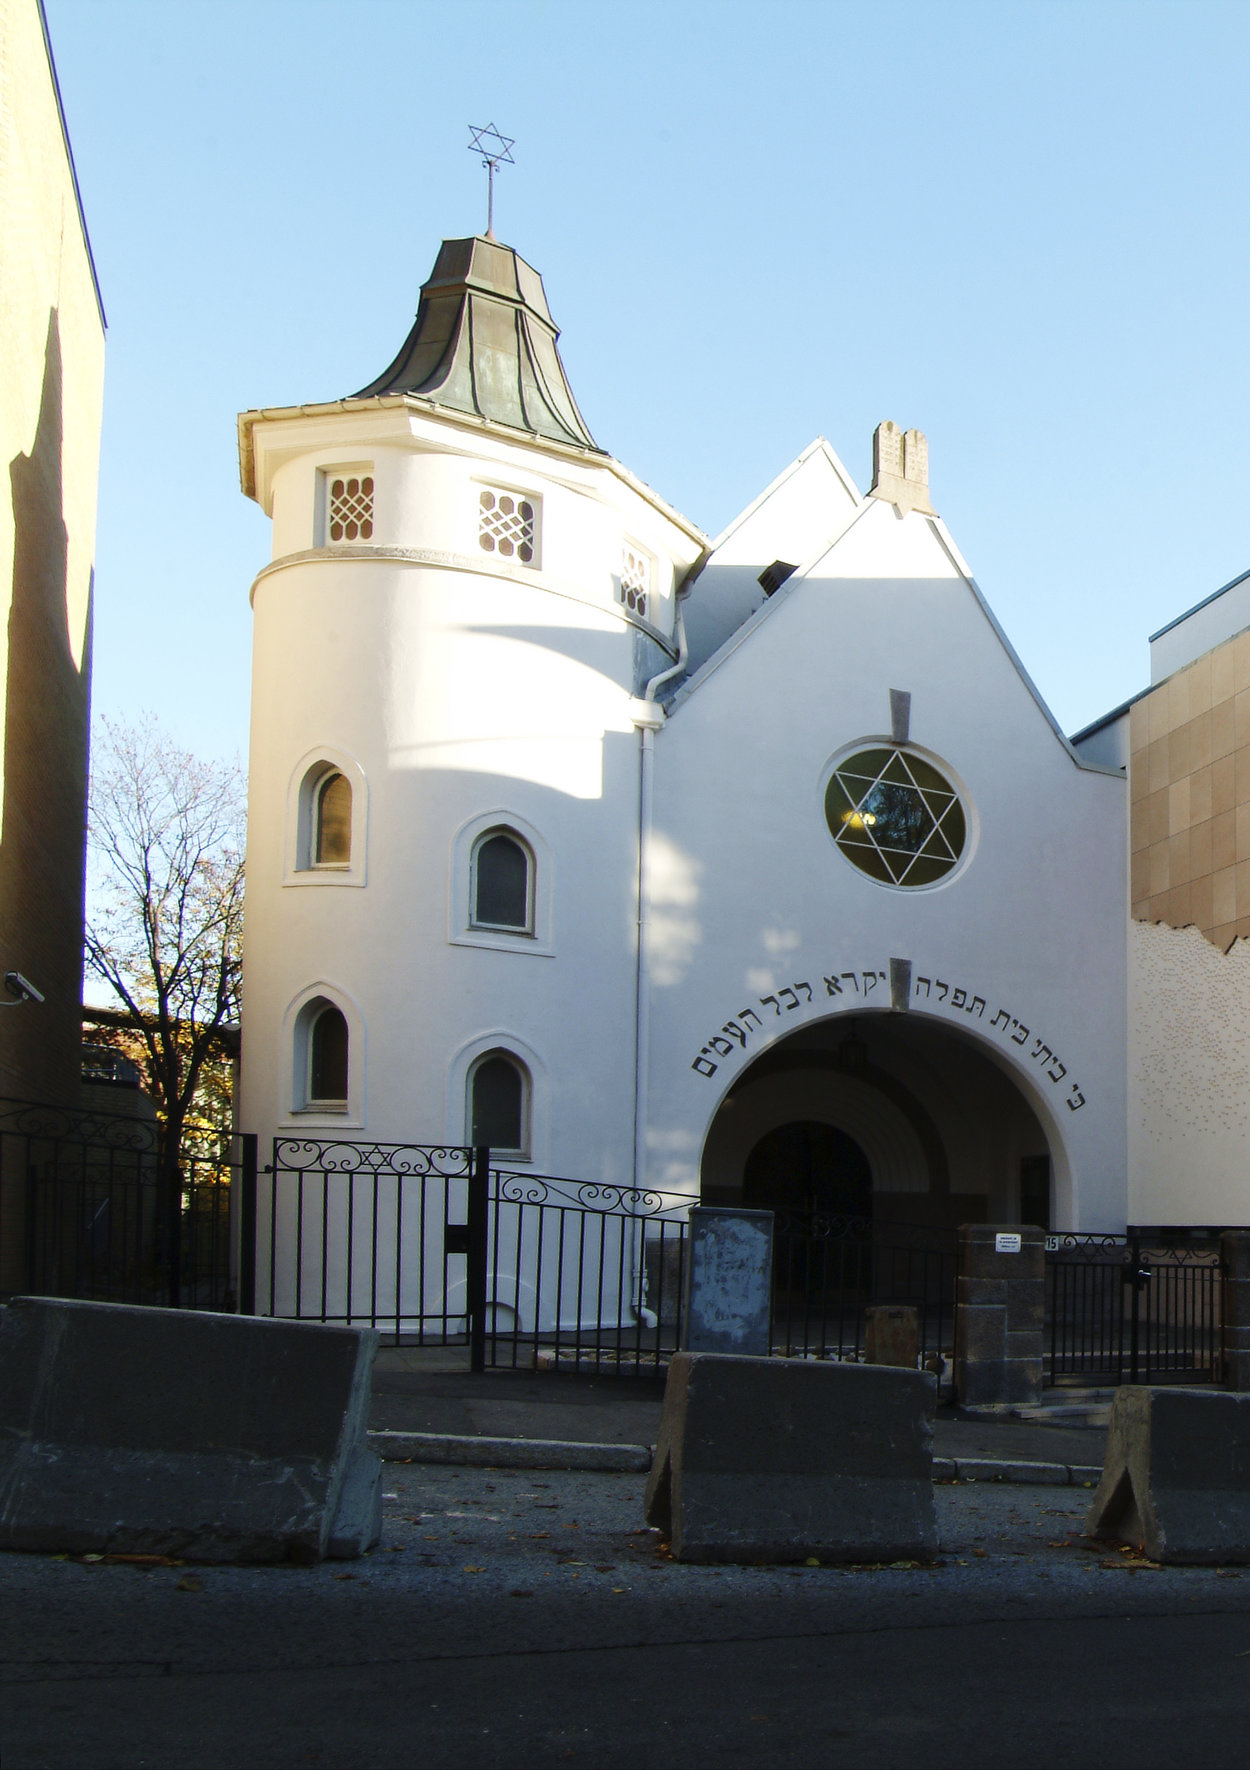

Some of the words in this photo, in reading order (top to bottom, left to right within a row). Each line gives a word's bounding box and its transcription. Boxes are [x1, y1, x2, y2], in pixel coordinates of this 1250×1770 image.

[759, 982, 813, 1016] לכל
[823, 971, 886, 997] יקרא
[691, 1008, 763, 1079] העמים
[1047, 1237, 1057, 1249] 15
